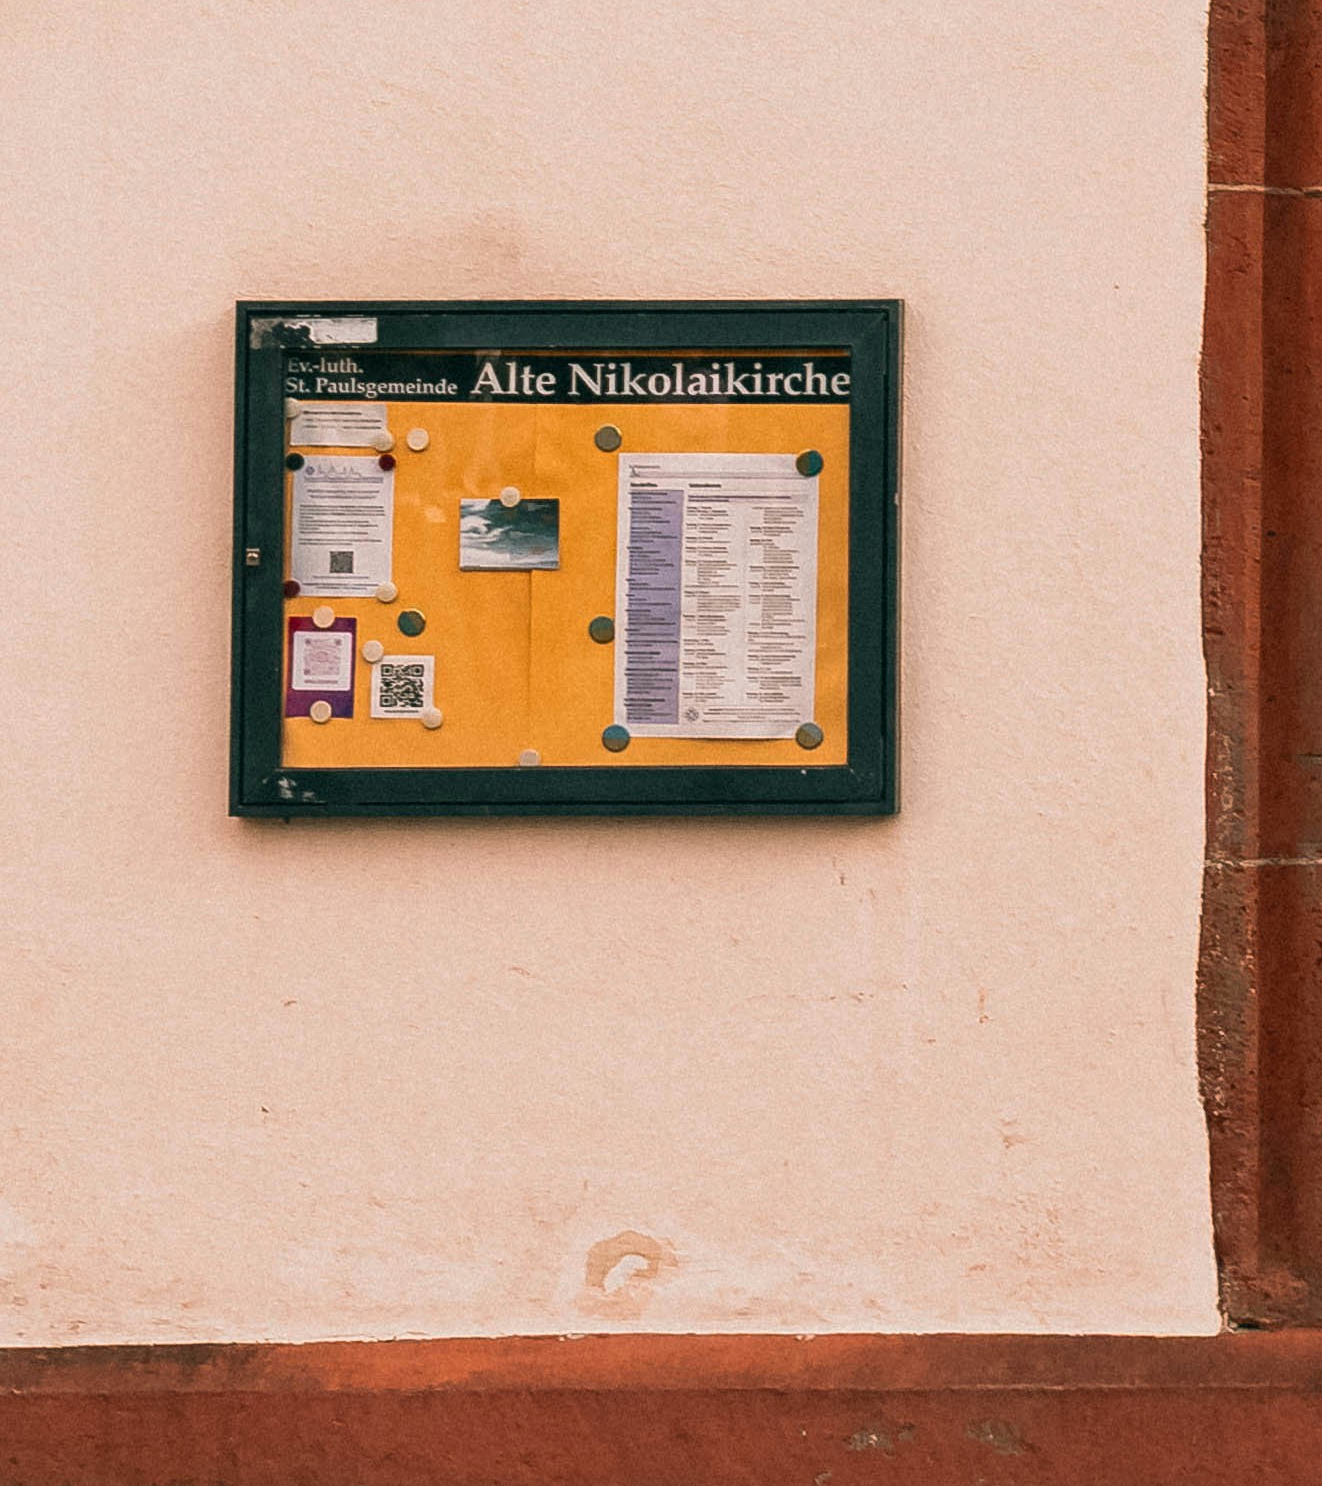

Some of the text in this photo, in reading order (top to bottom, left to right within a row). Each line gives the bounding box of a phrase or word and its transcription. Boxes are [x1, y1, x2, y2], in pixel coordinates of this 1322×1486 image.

[288, 358, 364, 375] Ev.-luth.
[285, 377, 459, 399] St. Paulsgemeinde
[470, 362, 850, 396] Alte Nikolaikirche
